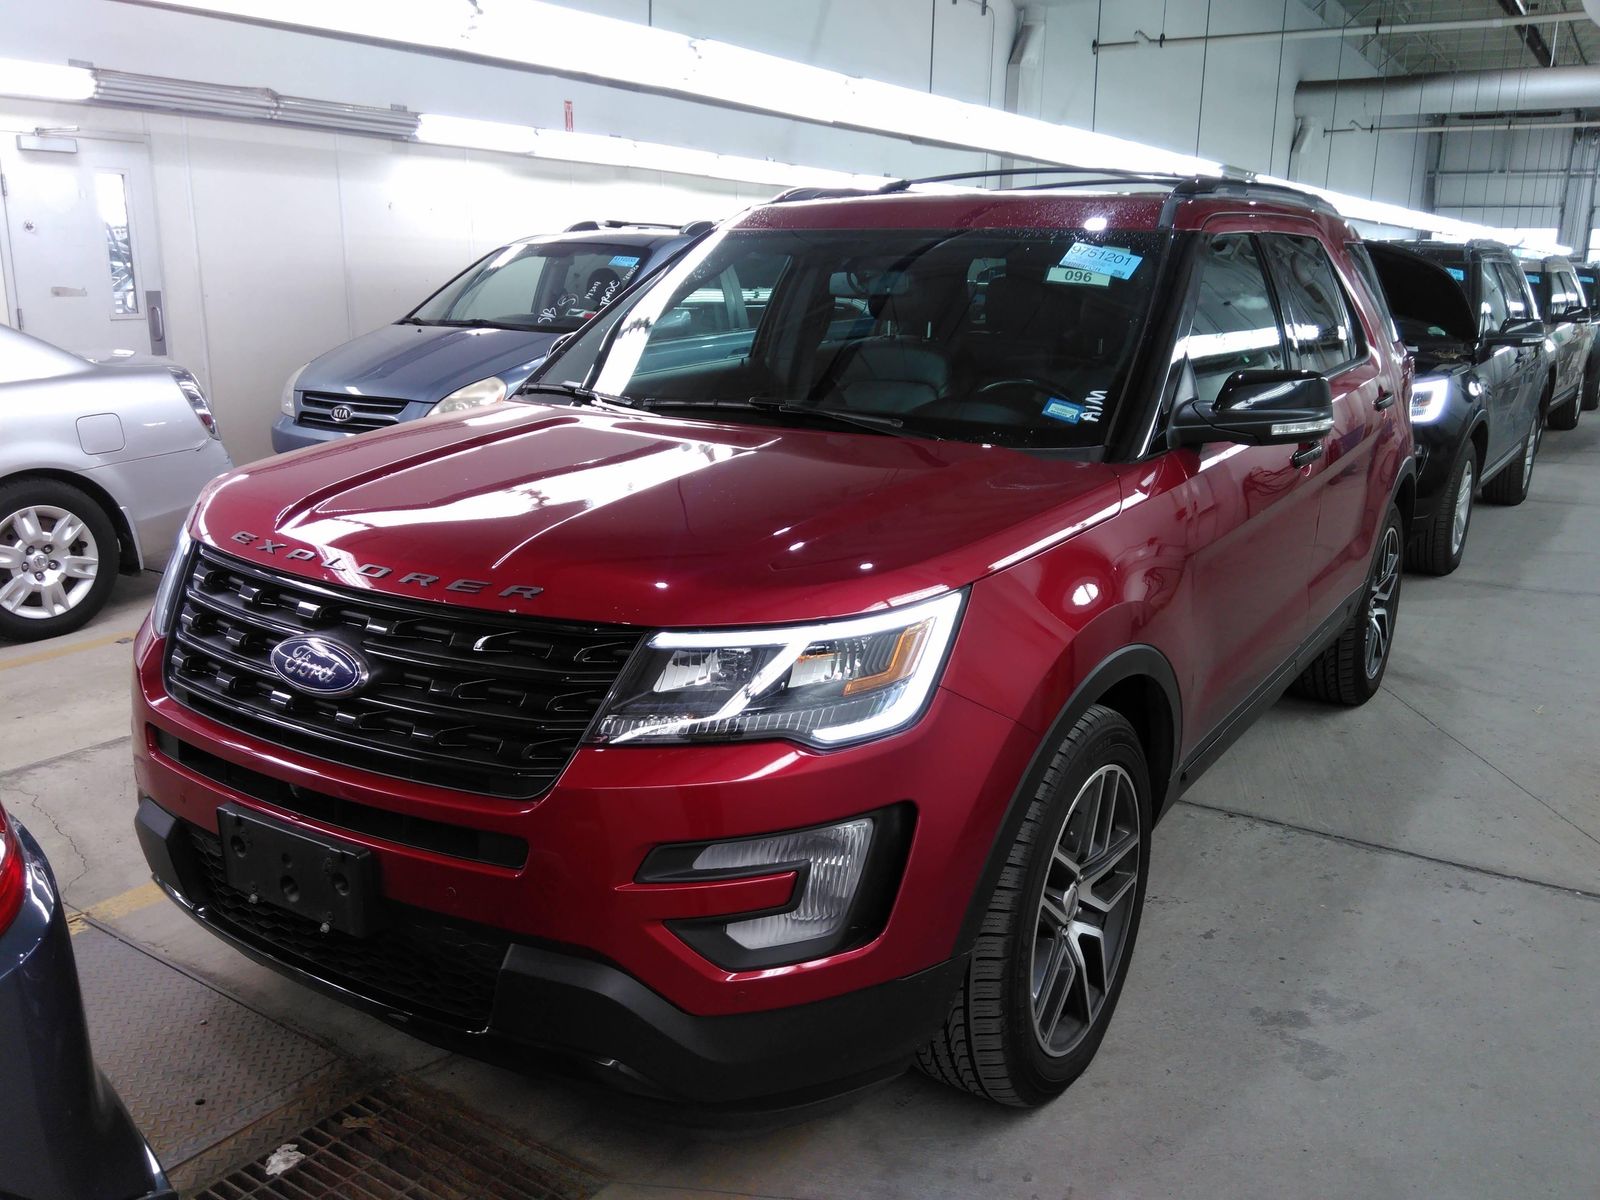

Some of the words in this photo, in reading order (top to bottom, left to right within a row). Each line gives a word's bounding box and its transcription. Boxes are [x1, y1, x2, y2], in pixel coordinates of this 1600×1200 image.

[1069, 244, 1133, 266] 9751201
[1064, 270, 1093, 283] 096
[333, 408, 349, 419] KIA
[1080, 390, 1109, 422] AIM
[231, 530, 545, 600] EXPLORER
[284, 644, 338, 683] Ford
